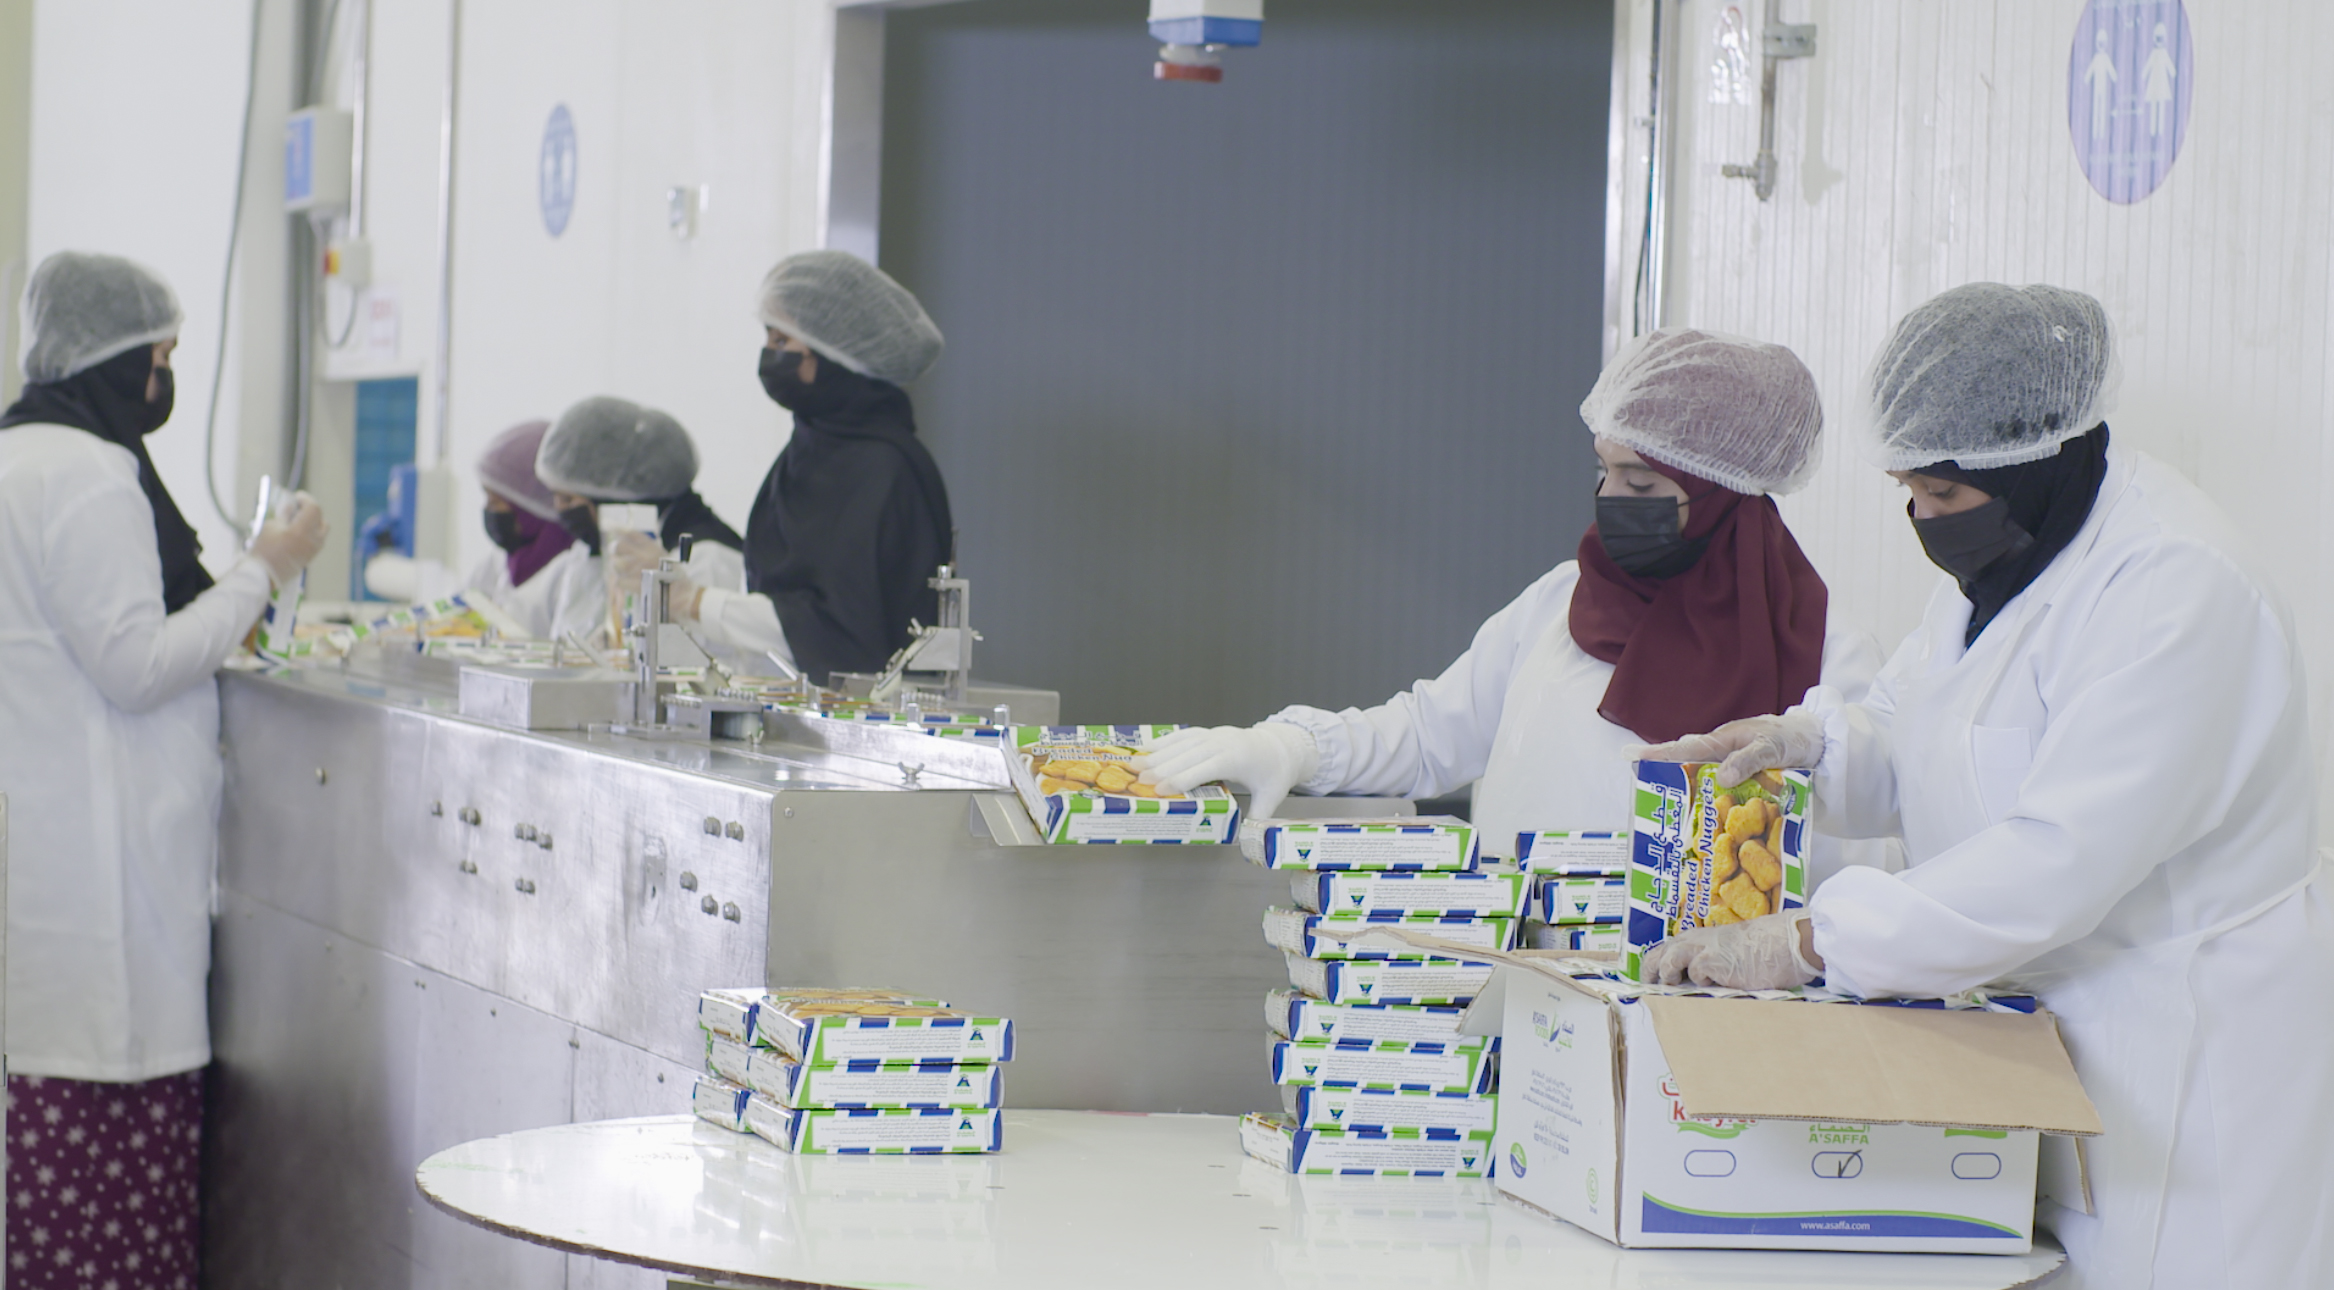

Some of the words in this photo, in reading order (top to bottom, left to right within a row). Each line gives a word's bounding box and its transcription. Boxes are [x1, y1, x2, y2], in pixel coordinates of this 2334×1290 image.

[1651, 782, 1667, 844] قطع
[1669, 787, 1684, 847] المغطى
[1699, 778, 1719, 856] Nuggets
[1646, 844, 1665, 912] الدجاج
[1681, 860, 1699, 931] Breaded
[1697, 855, 1713, 918] Chicken
[1808, 1133, 1870, 1144] A'SAFFA
[1800, 1221, 1871, 1231] www.asaffa.com
